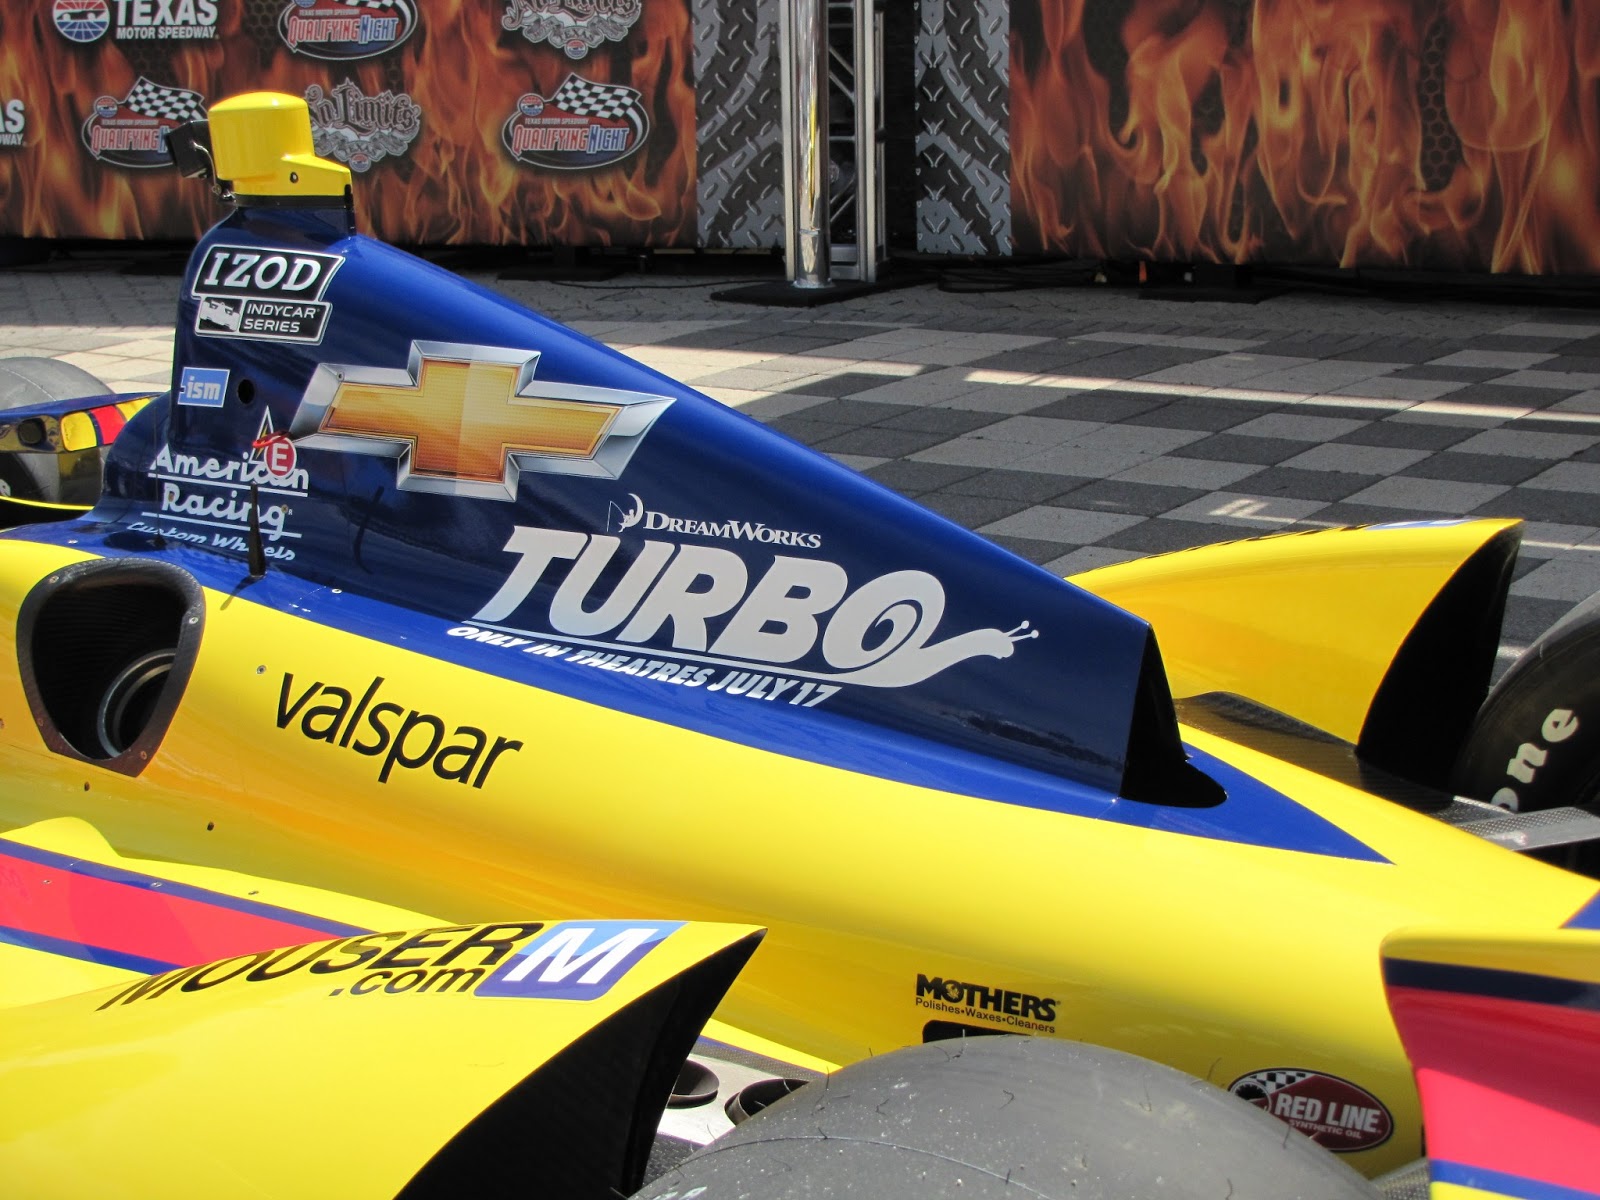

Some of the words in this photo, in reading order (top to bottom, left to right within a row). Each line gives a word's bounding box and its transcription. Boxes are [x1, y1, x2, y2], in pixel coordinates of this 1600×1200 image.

[114, 0, 218, 26] TEXAS
[116, 26, 156, 39] MOTOR
[157, 26, 216, 39] SPEEDWAY
[204, 252, 321, 291] IZOD
[243, 318, 300, 333] SERIES
[247, 303, 316, 319] INDYCAR
[186, 375, 221, 400] ism
[466, 526, 948, 688] TURBO
[446, 627, 526, 648] ONLY
[523, 641, 568, 658] IN
[564, 649, 715, 688] THEATRES
[707, 671, 803, 702] JULY
[796, 683, 842, 708] 17
[276, 672, 524, 789] valspar
[95, 922, 545, 1011] MOUSER
[915, 974, 1056, 1022] MOTHERS
[1274, 1092, 1322, 1122] RED
[1325, 1101, 1381, 1133] LINE
